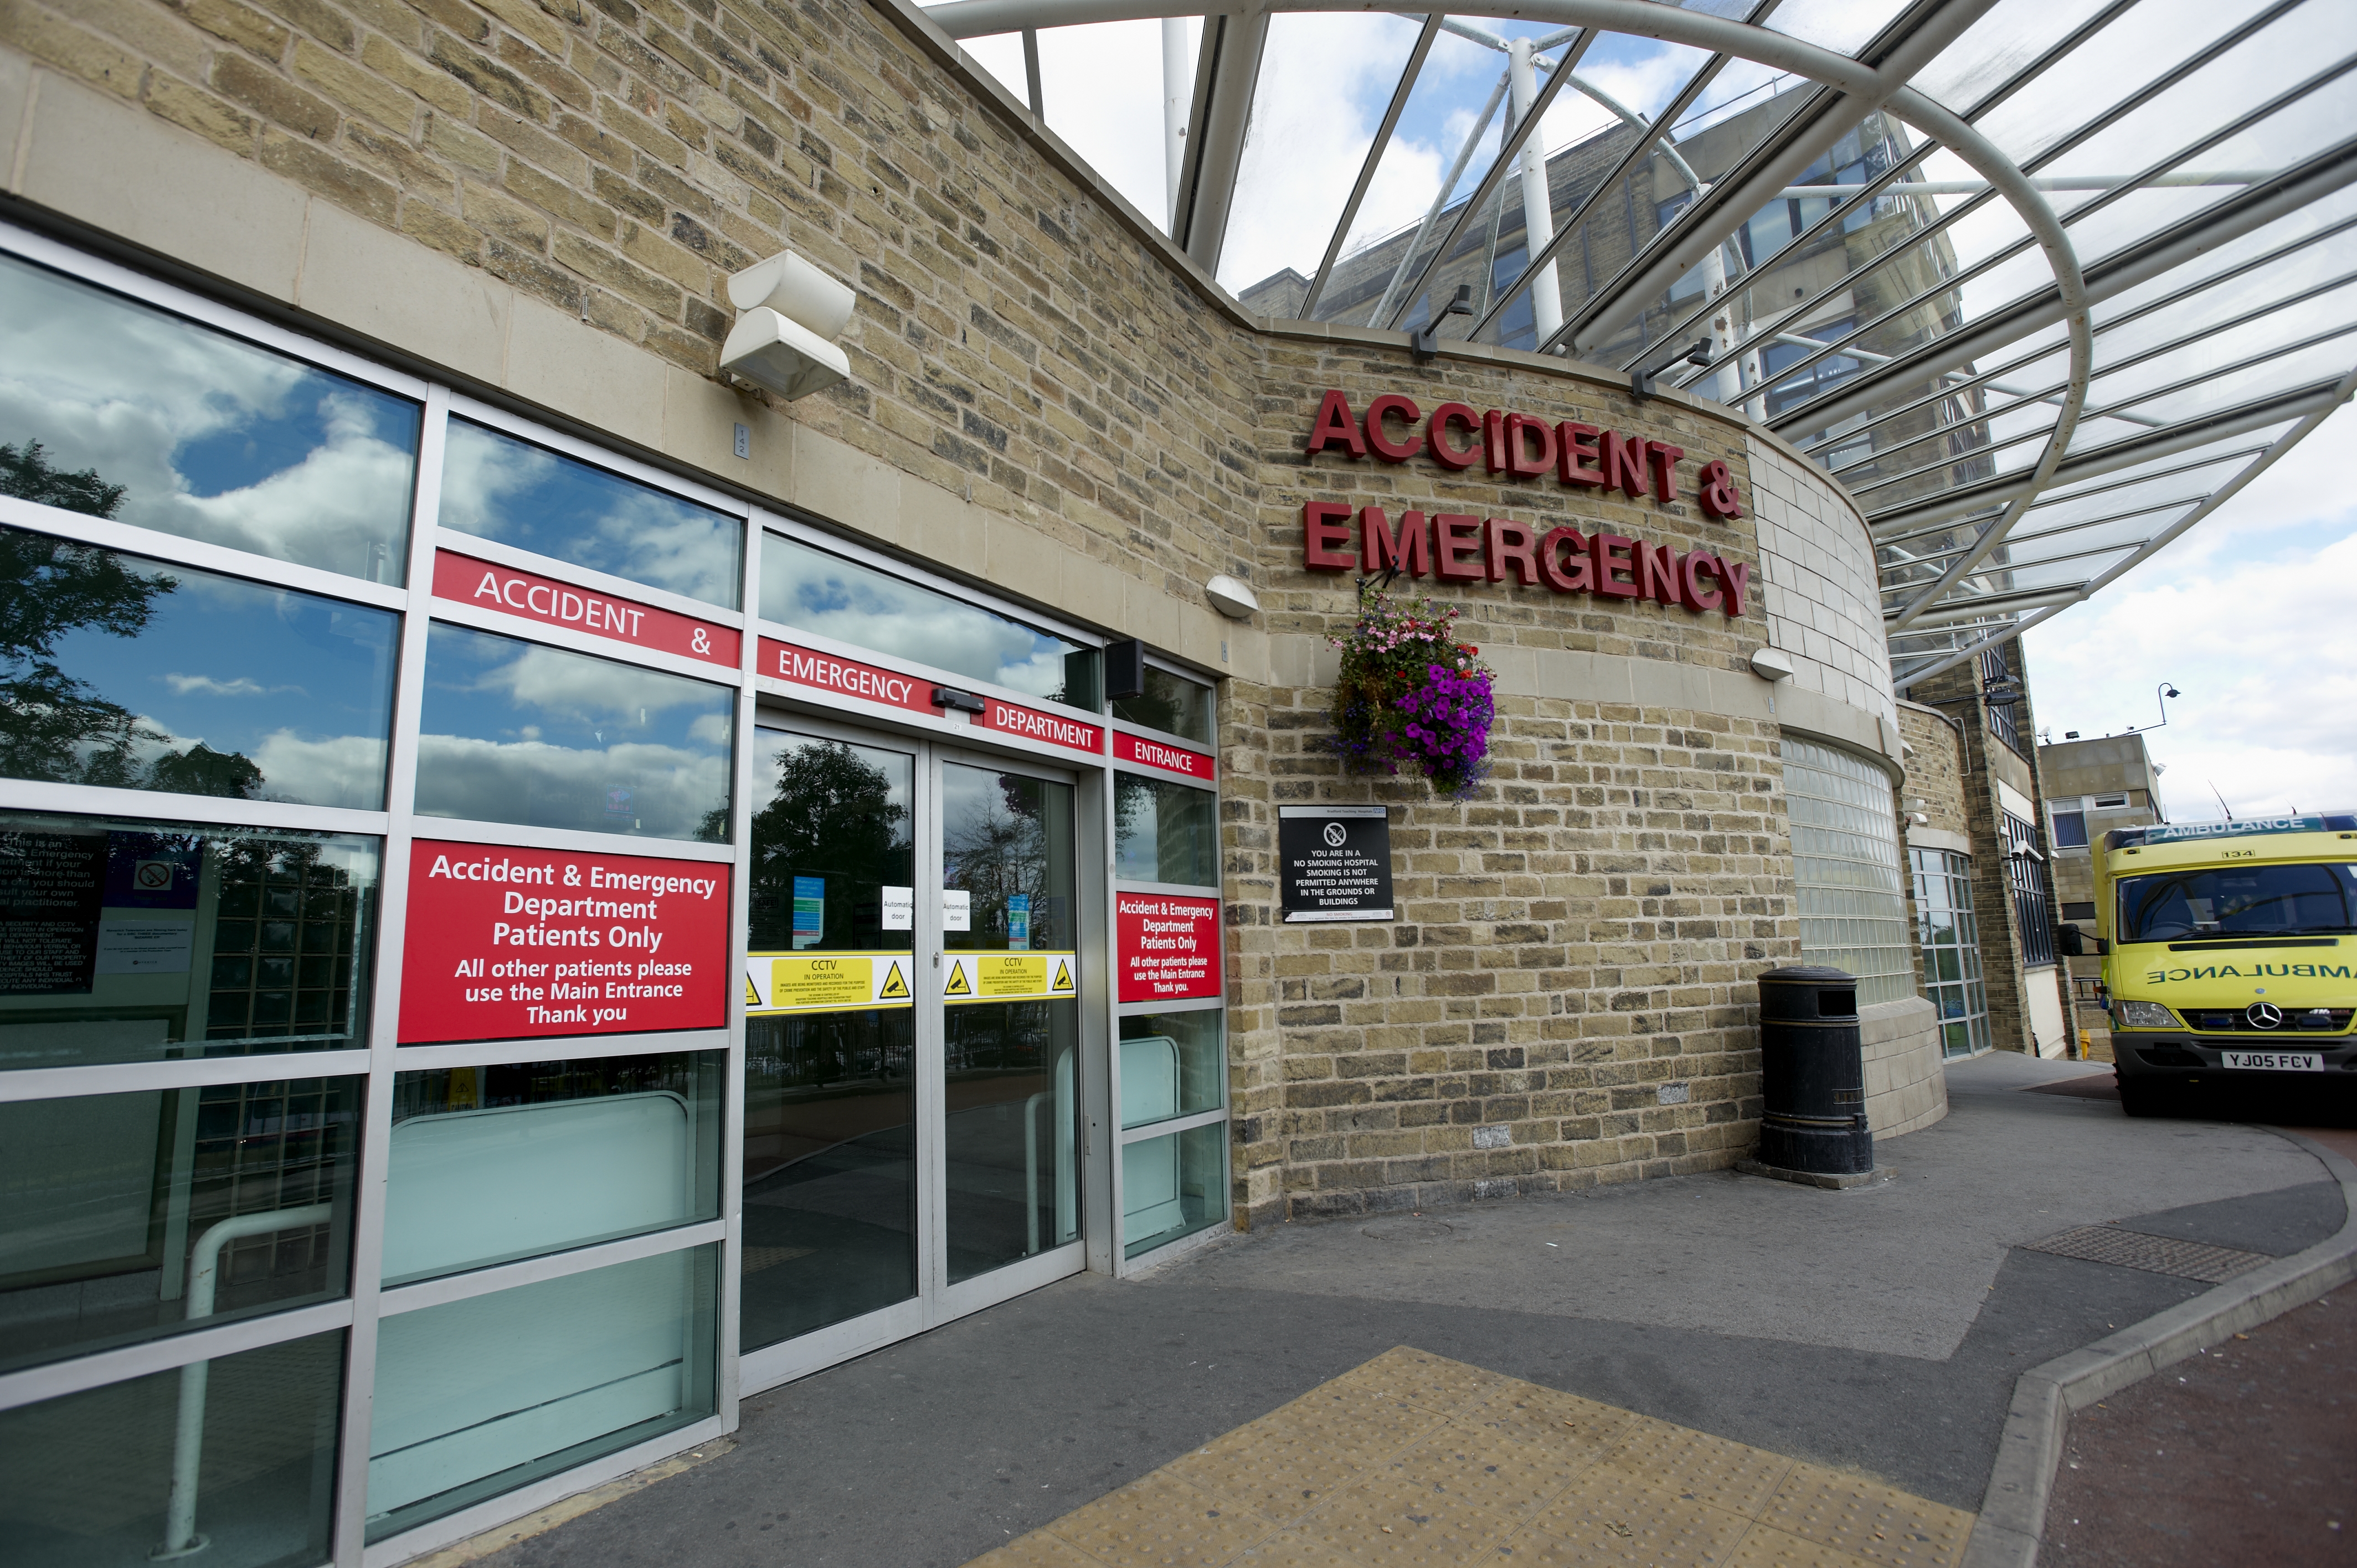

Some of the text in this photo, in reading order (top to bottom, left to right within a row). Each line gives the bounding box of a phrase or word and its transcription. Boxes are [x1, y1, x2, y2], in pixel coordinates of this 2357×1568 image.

[1306, 389, 1743, 520] ACCIDENT &
[1303, 501, 1750, 618] EMERGENCY
[474, 572, 1192, 772] ACCIDENT & EMERGENCY DEPARTMENT ENTRANCE
[2163, 818, 2305, 838] AMBULANCE
[30, 849, 94, 860] Emergency
[56, 860, 81, 869] your
[66, 870, 90, 878] than
[429, 855, 716, 899] Accident & Emergency
[33, 880, 54, 889] you
[57, 879, 95, 888] should
[22, 889, 48, 898] your
[13, 898, 80, 907] practitioner.
[504, 893, 657, 920] Department
[1120, 900, 1213, 920] Accident & Emergency
[1143, 919, 1193, 935] Department
[493, 923, 662, 953] Patients Only
[1141, 936, 1196, 952] Patients Only
[455, 959, 692, 981] All other patients please
[811, 960, 837, 970] CCTV
[1004, 958, 1022, 966] CCTV
[1130, 956, 1207, 968] All other patients please
[1134, 969, 1205, 981] use the Main Entrance
[466, 982, 683, 1002] use the Main Entrance
[1154, 982, 1188, 994] Thank you.
[527, 1005, 627, 1025] Thank you
[2230, 1054, 2312, 1068] YJ05 FCV
